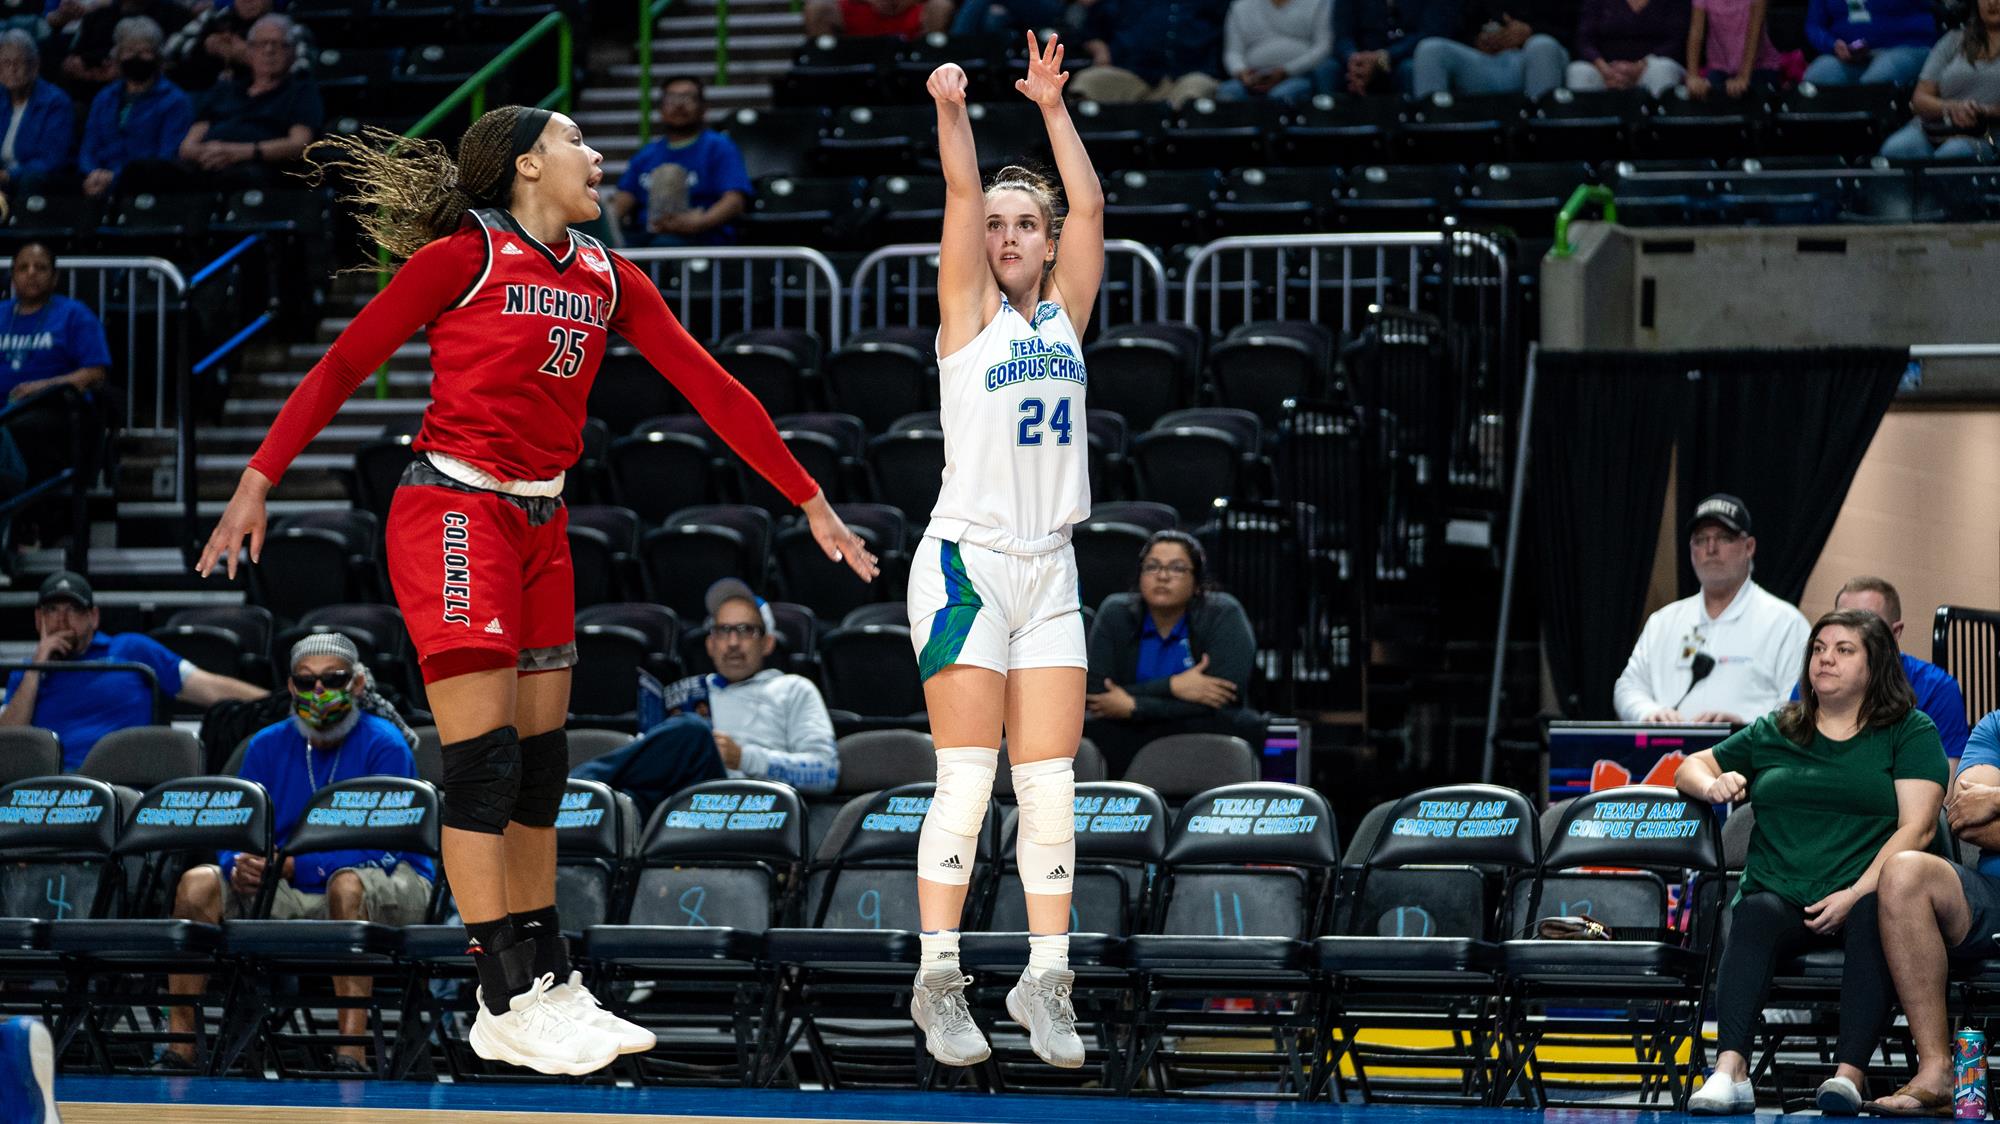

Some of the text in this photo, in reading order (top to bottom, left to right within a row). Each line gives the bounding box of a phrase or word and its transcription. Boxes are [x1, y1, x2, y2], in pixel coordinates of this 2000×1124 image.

[538, 326, 589, 378] 25
[987, 356, 1086, 391] CORPUS CHRIS
[1017, 397, 1072, 446] 24
[443, 511, 470, 628] COLONELS
[690, 794, 777, 811] TEXAS A&M
[1102, 797, 1141, 814] A&M
[1211, 798, 1305, 816] TEXAS A&M
[1416, 800, 1508, 819] TEXAS A&M
[1593, 802, 1687, 820] TEXAS A&M
[0, 806, 47, 824] ORPUS
[665, 811, 788, 830] CORPUS CHRISTI
[862, 813, 924, 832] CORPUS
[1090, 814, 1153, 832] CHRISTI
[1187, 815, 1318, 835] CORPUS CHRISTI
[1392, 818, 1520, 838] CORPUS CHRISTI
[1568, 820, 1700, 838] CORPUS CHRISTI
[940, 861, 963, 870] adidas
[1046, 872, 1070, 881] adidas
[47, 874, 71, 919] 4
[857, 890, 881, 929] 9
